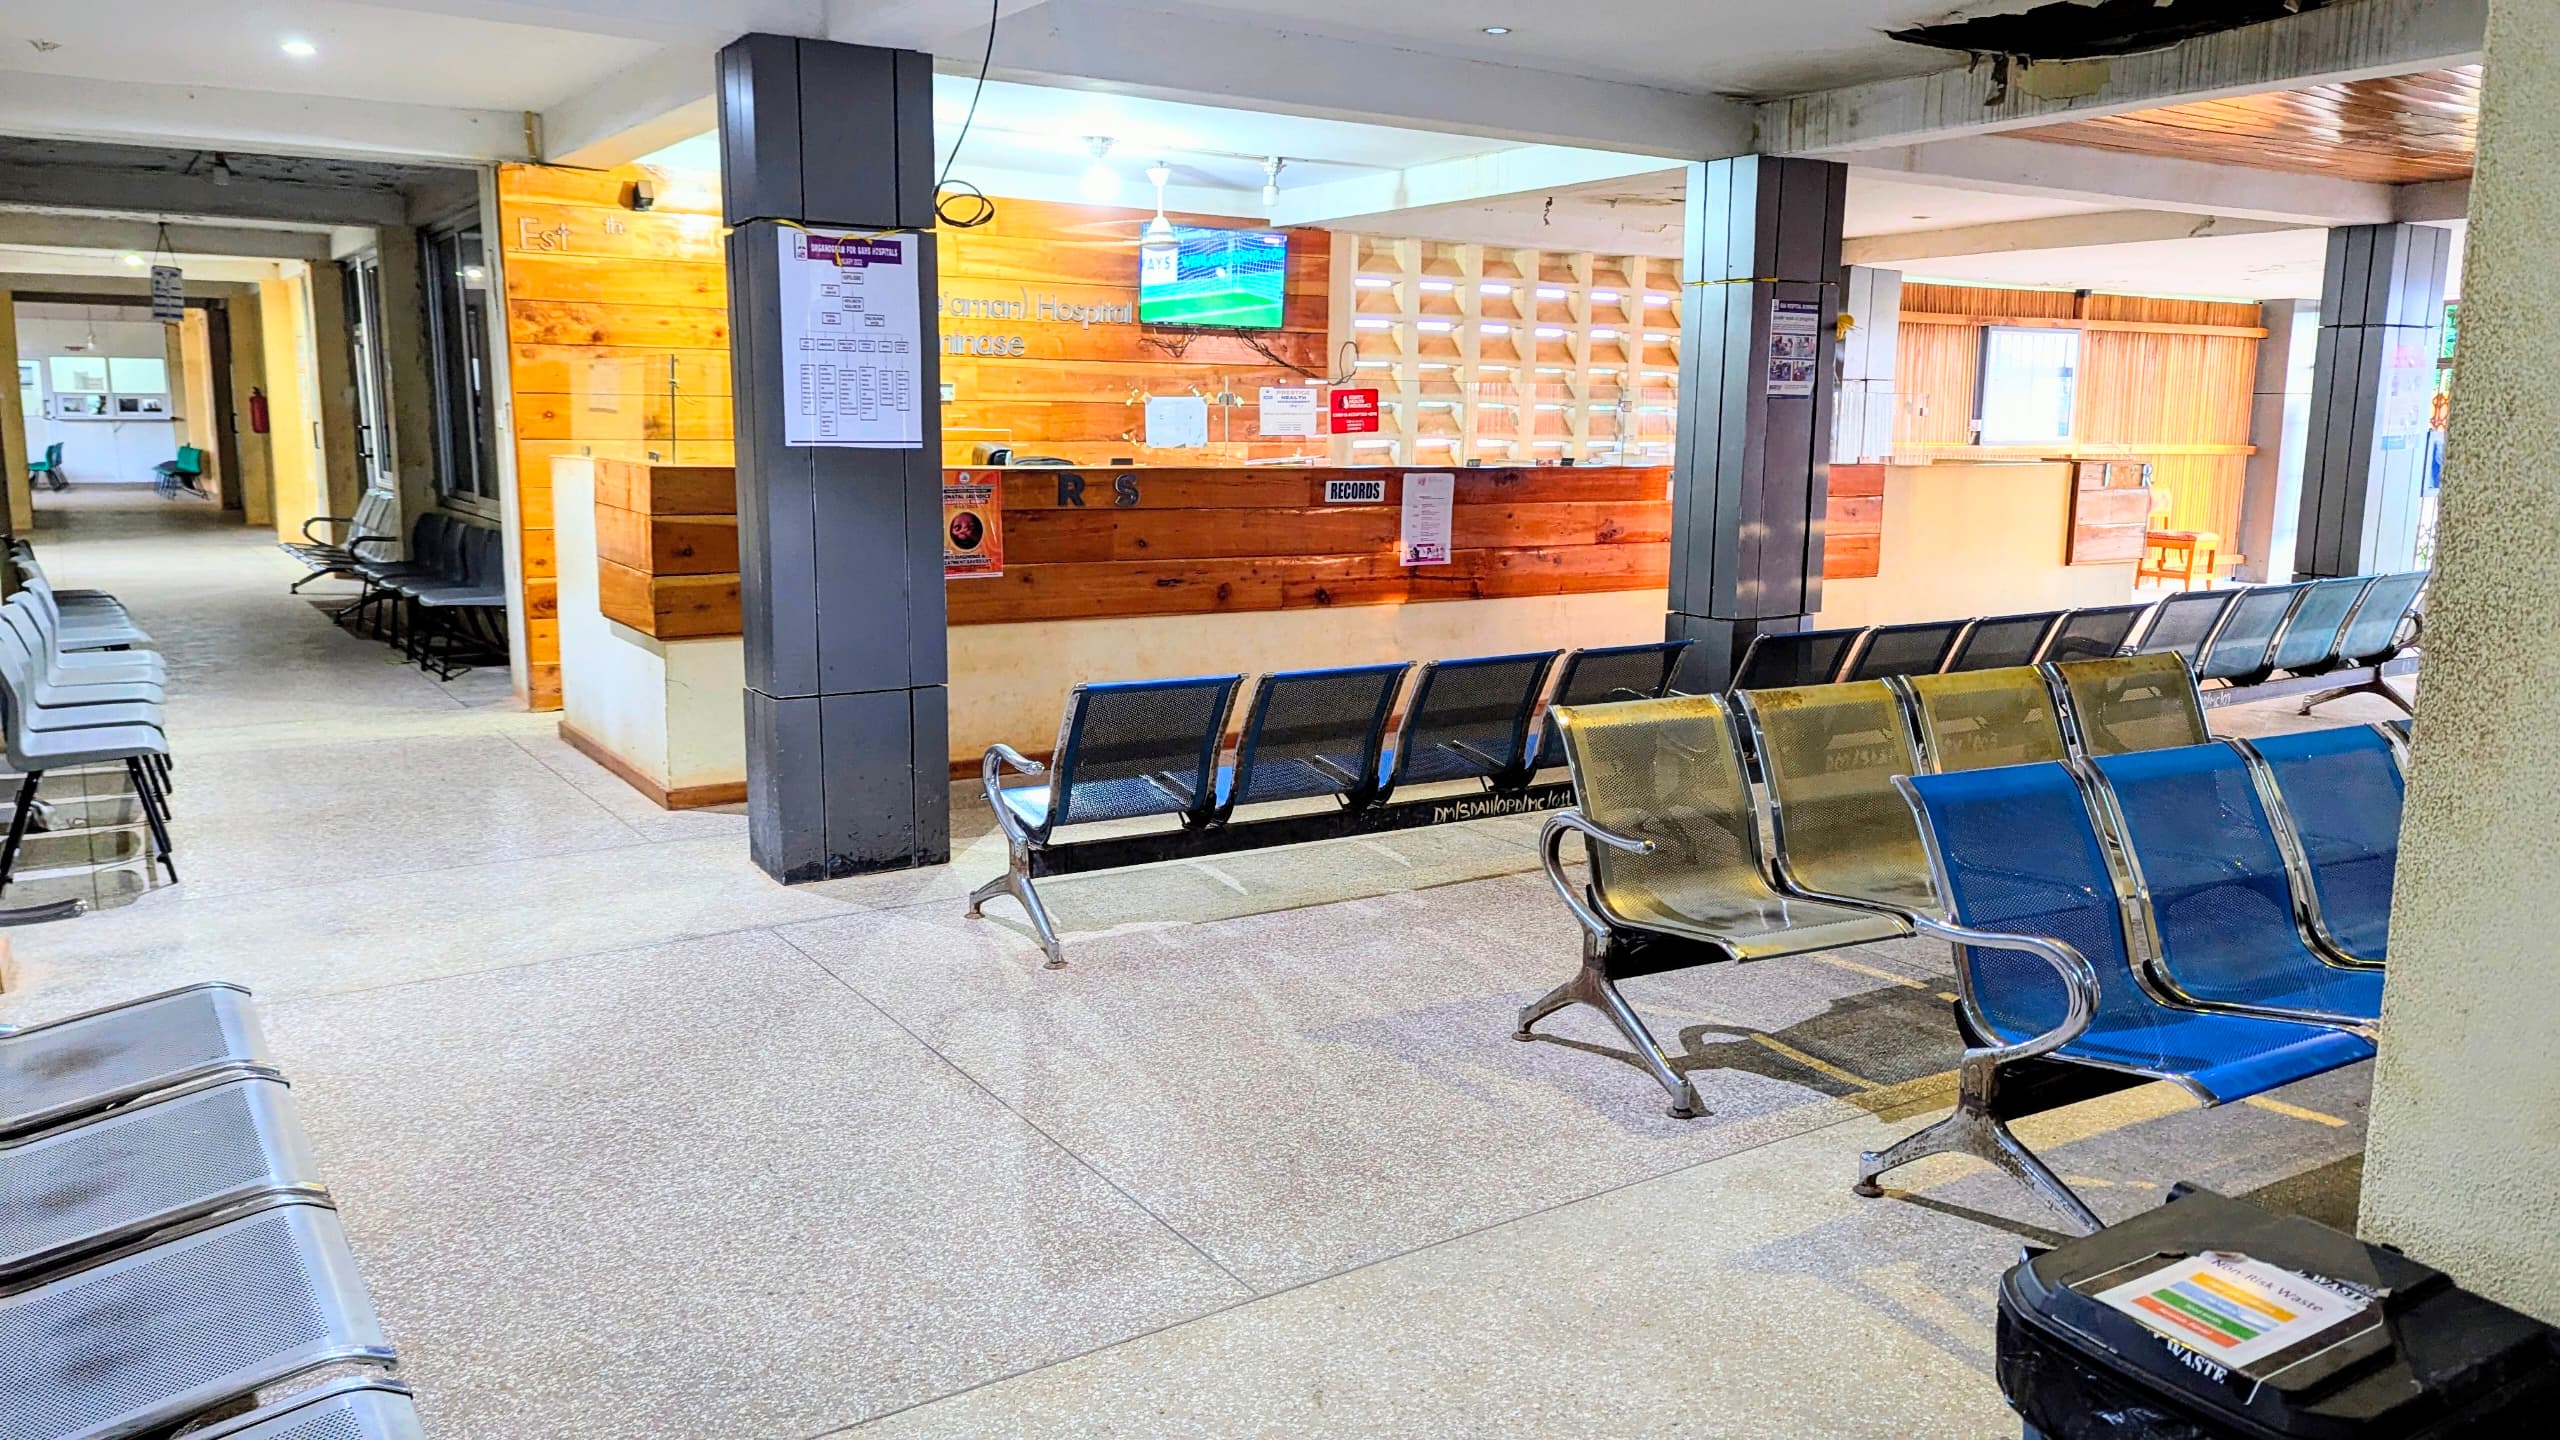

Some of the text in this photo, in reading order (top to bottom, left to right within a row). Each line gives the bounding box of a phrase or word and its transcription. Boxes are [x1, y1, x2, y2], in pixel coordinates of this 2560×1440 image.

[518, 216, 569, 251] Est
[811, 243, 846, 254] ORGANOGAM
[1037, 293, 1133, 330] Hospital
[1057, 472, 1140, 507] R S
[1330, 482, 1381, 500] RECORDS
[2211, 1257, 2274, 1291] Non-Risk
[2277, 1286, 2325, 1313] Waste
[2166, 1340, 2228, 1385] WASTE
